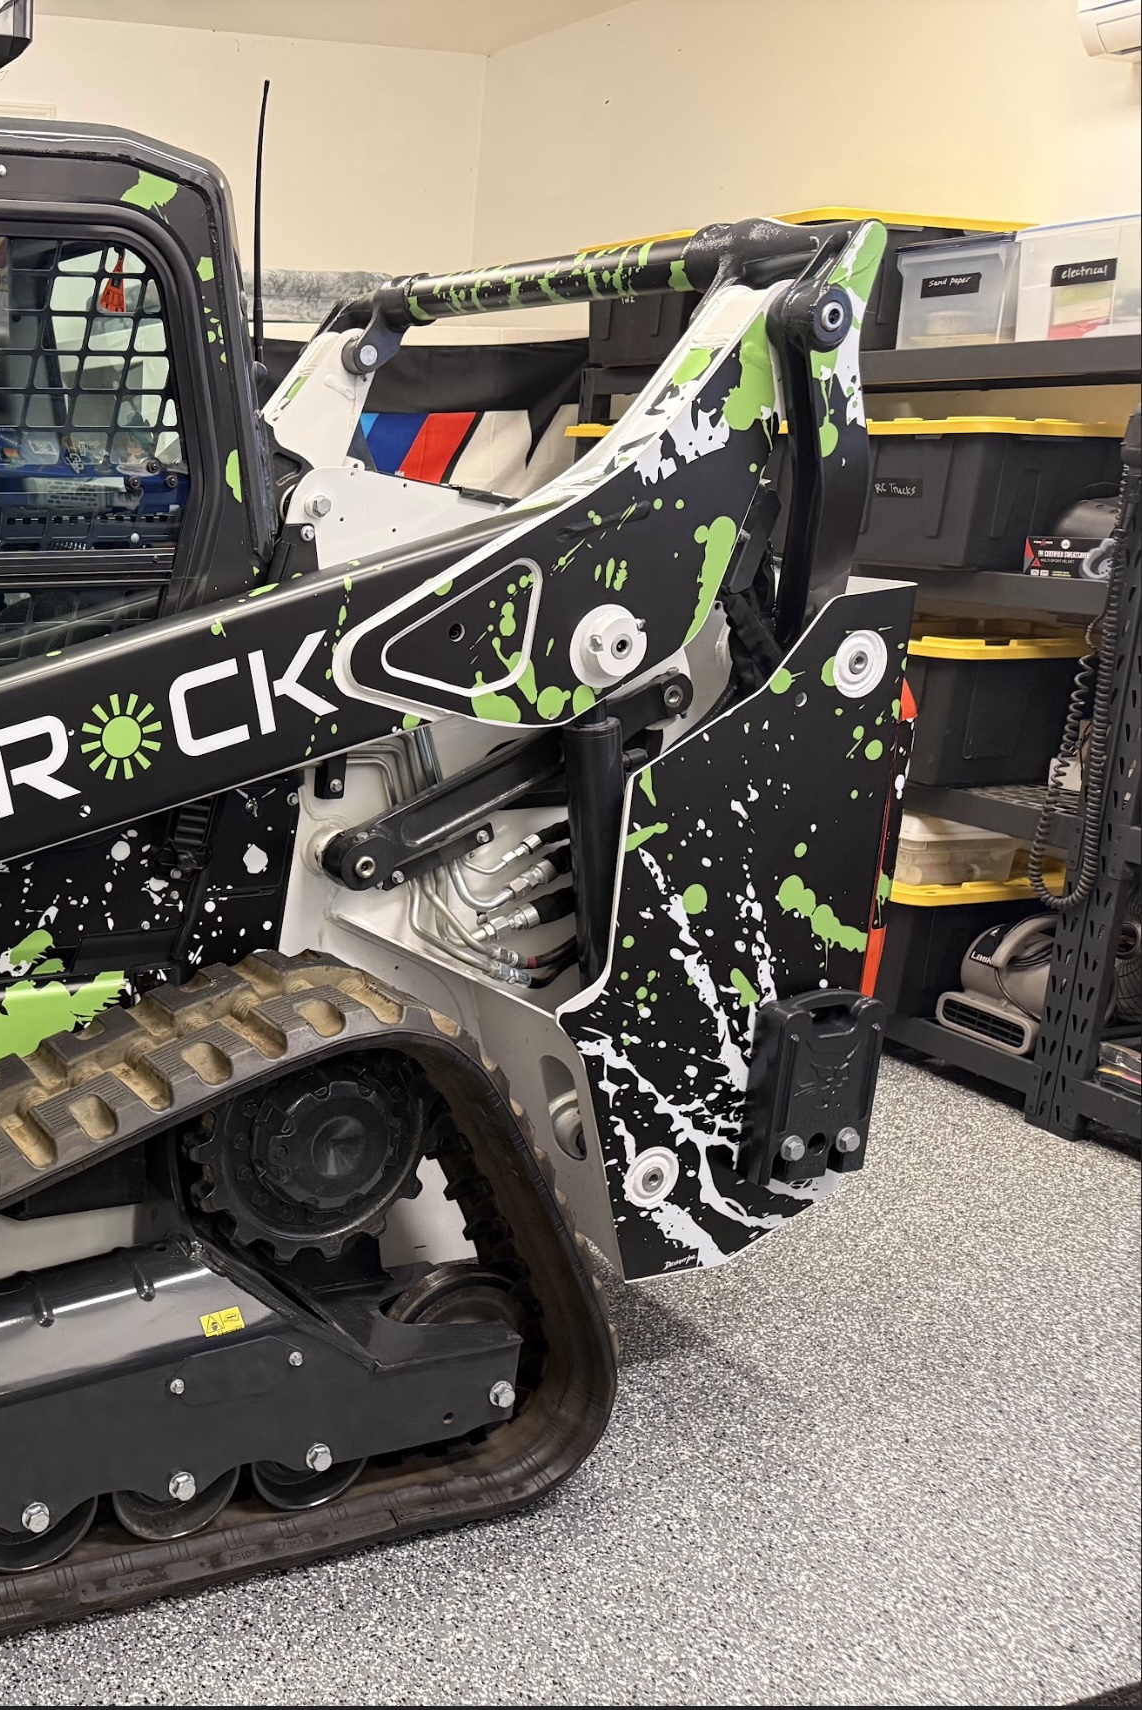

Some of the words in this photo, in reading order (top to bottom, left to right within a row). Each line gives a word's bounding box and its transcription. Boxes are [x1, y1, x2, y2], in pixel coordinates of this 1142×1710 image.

[1061, 264, 1108, 279] electrical
[928, 277, 948, 288] Sand
[874, 482, 887, 494] RC
[888, 482, 916, 497] Trucks
[970, 950, 992, 965] Lask
